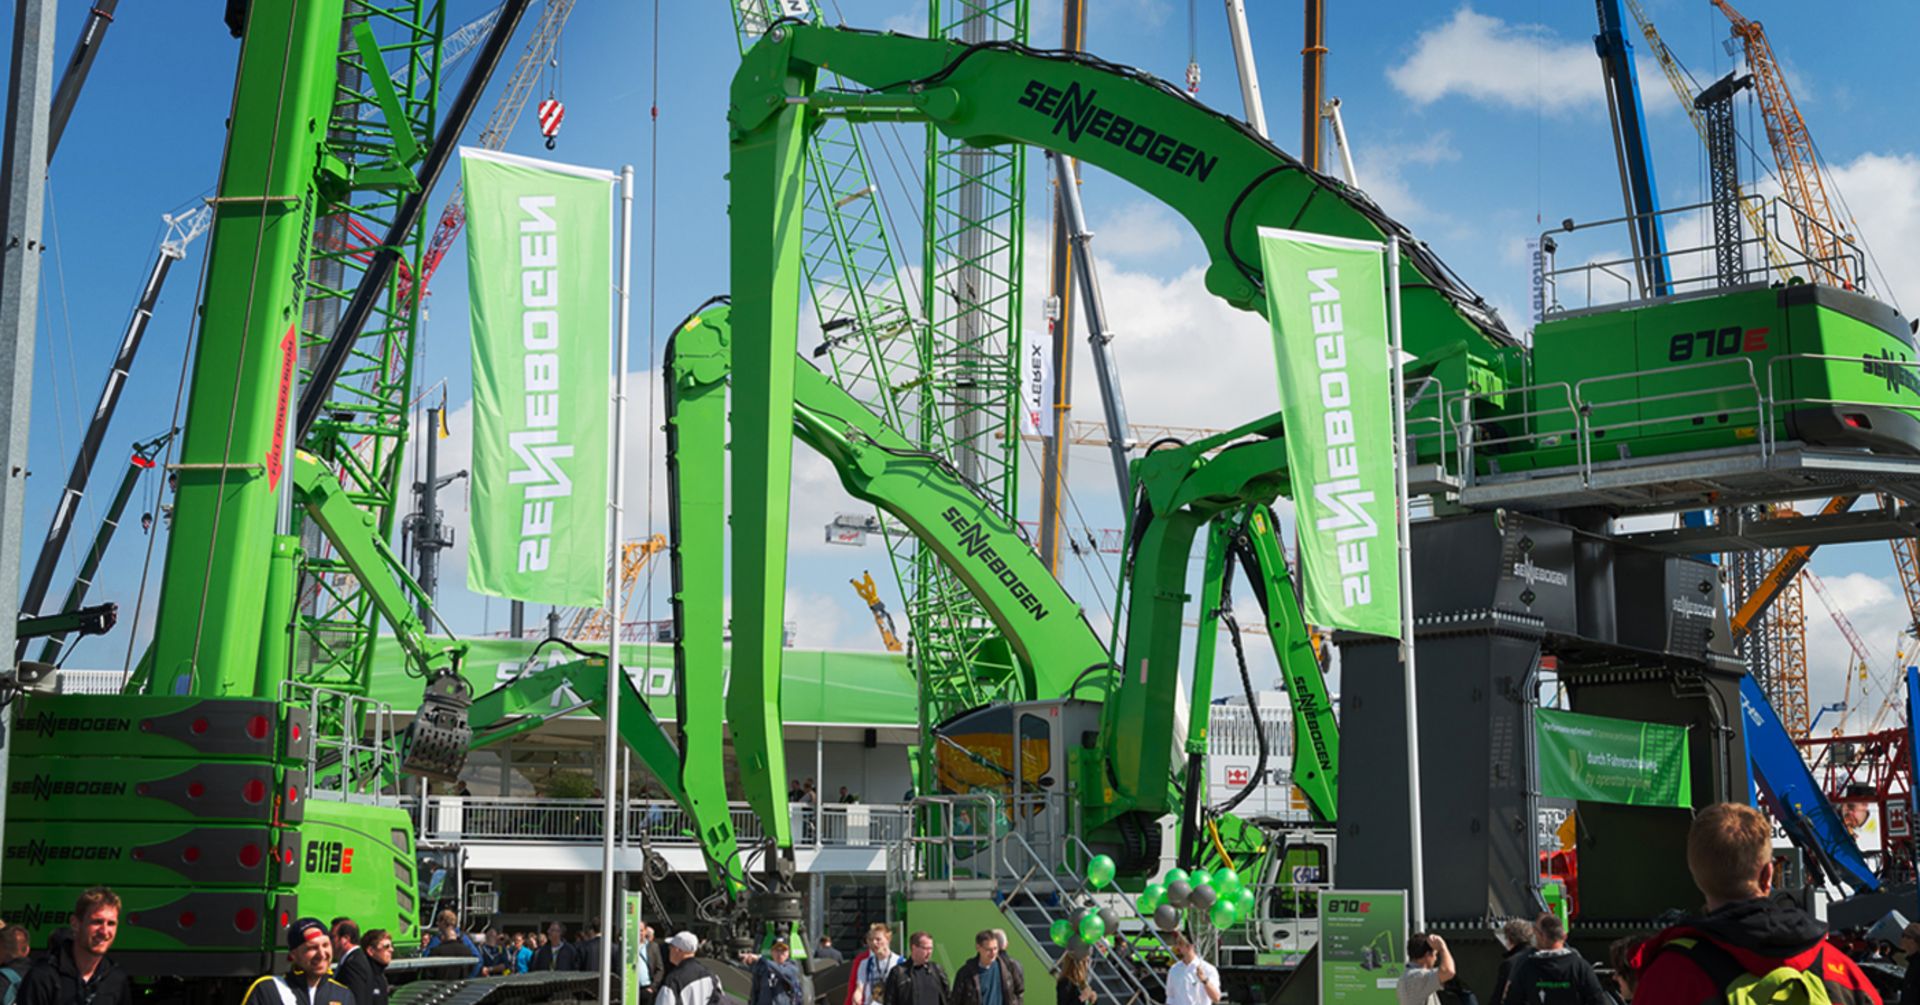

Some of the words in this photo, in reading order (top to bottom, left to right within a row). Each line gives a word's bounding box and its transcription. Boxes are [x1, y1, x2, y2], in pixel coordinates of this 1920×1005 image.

[1017, 79, 1218, 183] SENNEBOGEN
[1669, 326, 1770, 362] 870E
[941, 506, 1049, 621] SENNEBOGEN
[1513, 552, 1567, 586] SENNEBOGEN
[16, 711, 131, 738] SENNEBOGEN
[1293, 675, 1332, 771] SENNEBOGEN
[10, 774, 126, 801] SENNEBOGEN
[6, 838, 122, 866] SENNEBOGEN
[305, 840, 354, 874] 6113E
[2, 903, 71, 931] SENNEB
[1328, 899, 1371, 913] 870E
